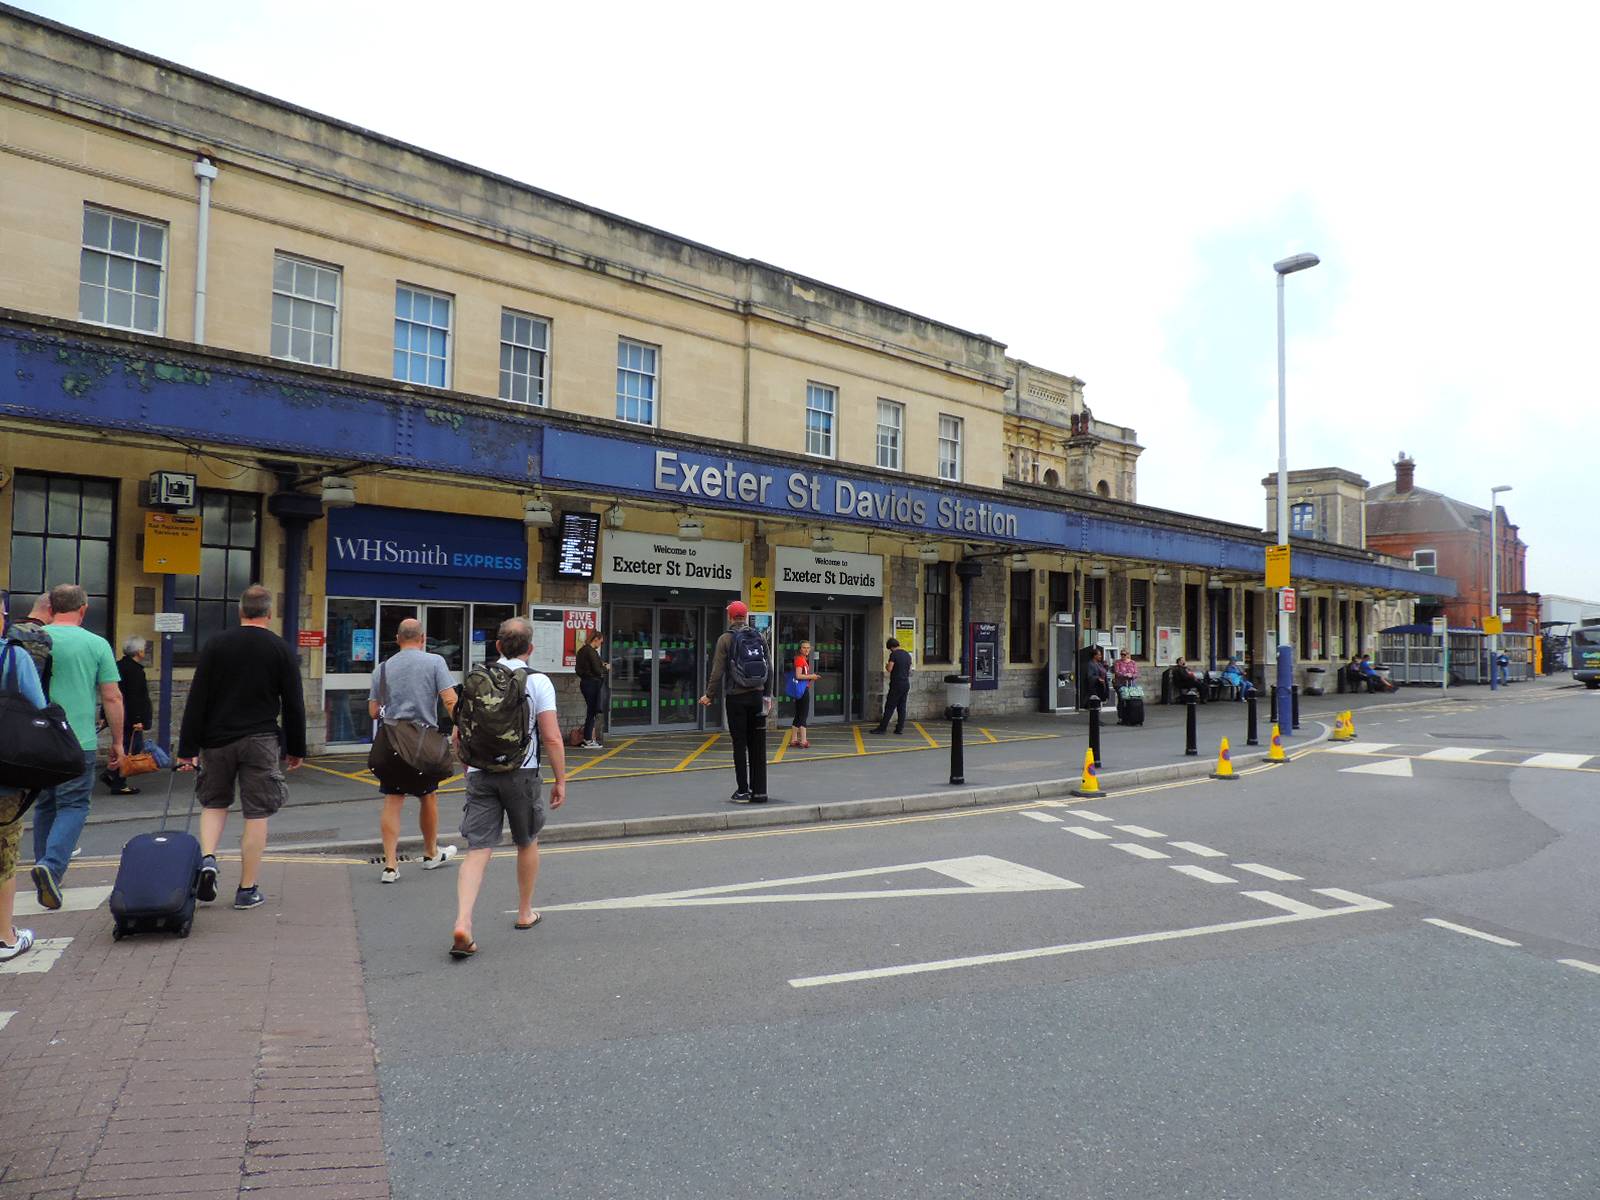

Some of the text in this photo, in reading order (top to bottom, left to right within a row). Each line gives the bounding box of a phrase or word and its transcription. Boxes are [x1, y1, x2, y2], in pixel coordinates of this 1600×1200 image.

[655, 450, 1018, 537] Exeter St Davids Station
[334, 537, 522, 570] WHSmith EXPRESS
[653, 544, 697, 556] Welcome to
[613, 556, 732, 580] Exeter St Davids
[814, 557, 840, 567] Welcome
[783, 567, 875, 587] Exeter St Davids
[569, 611, 592, 621] FIVE
[566, 620, 594, 629] GUYS
